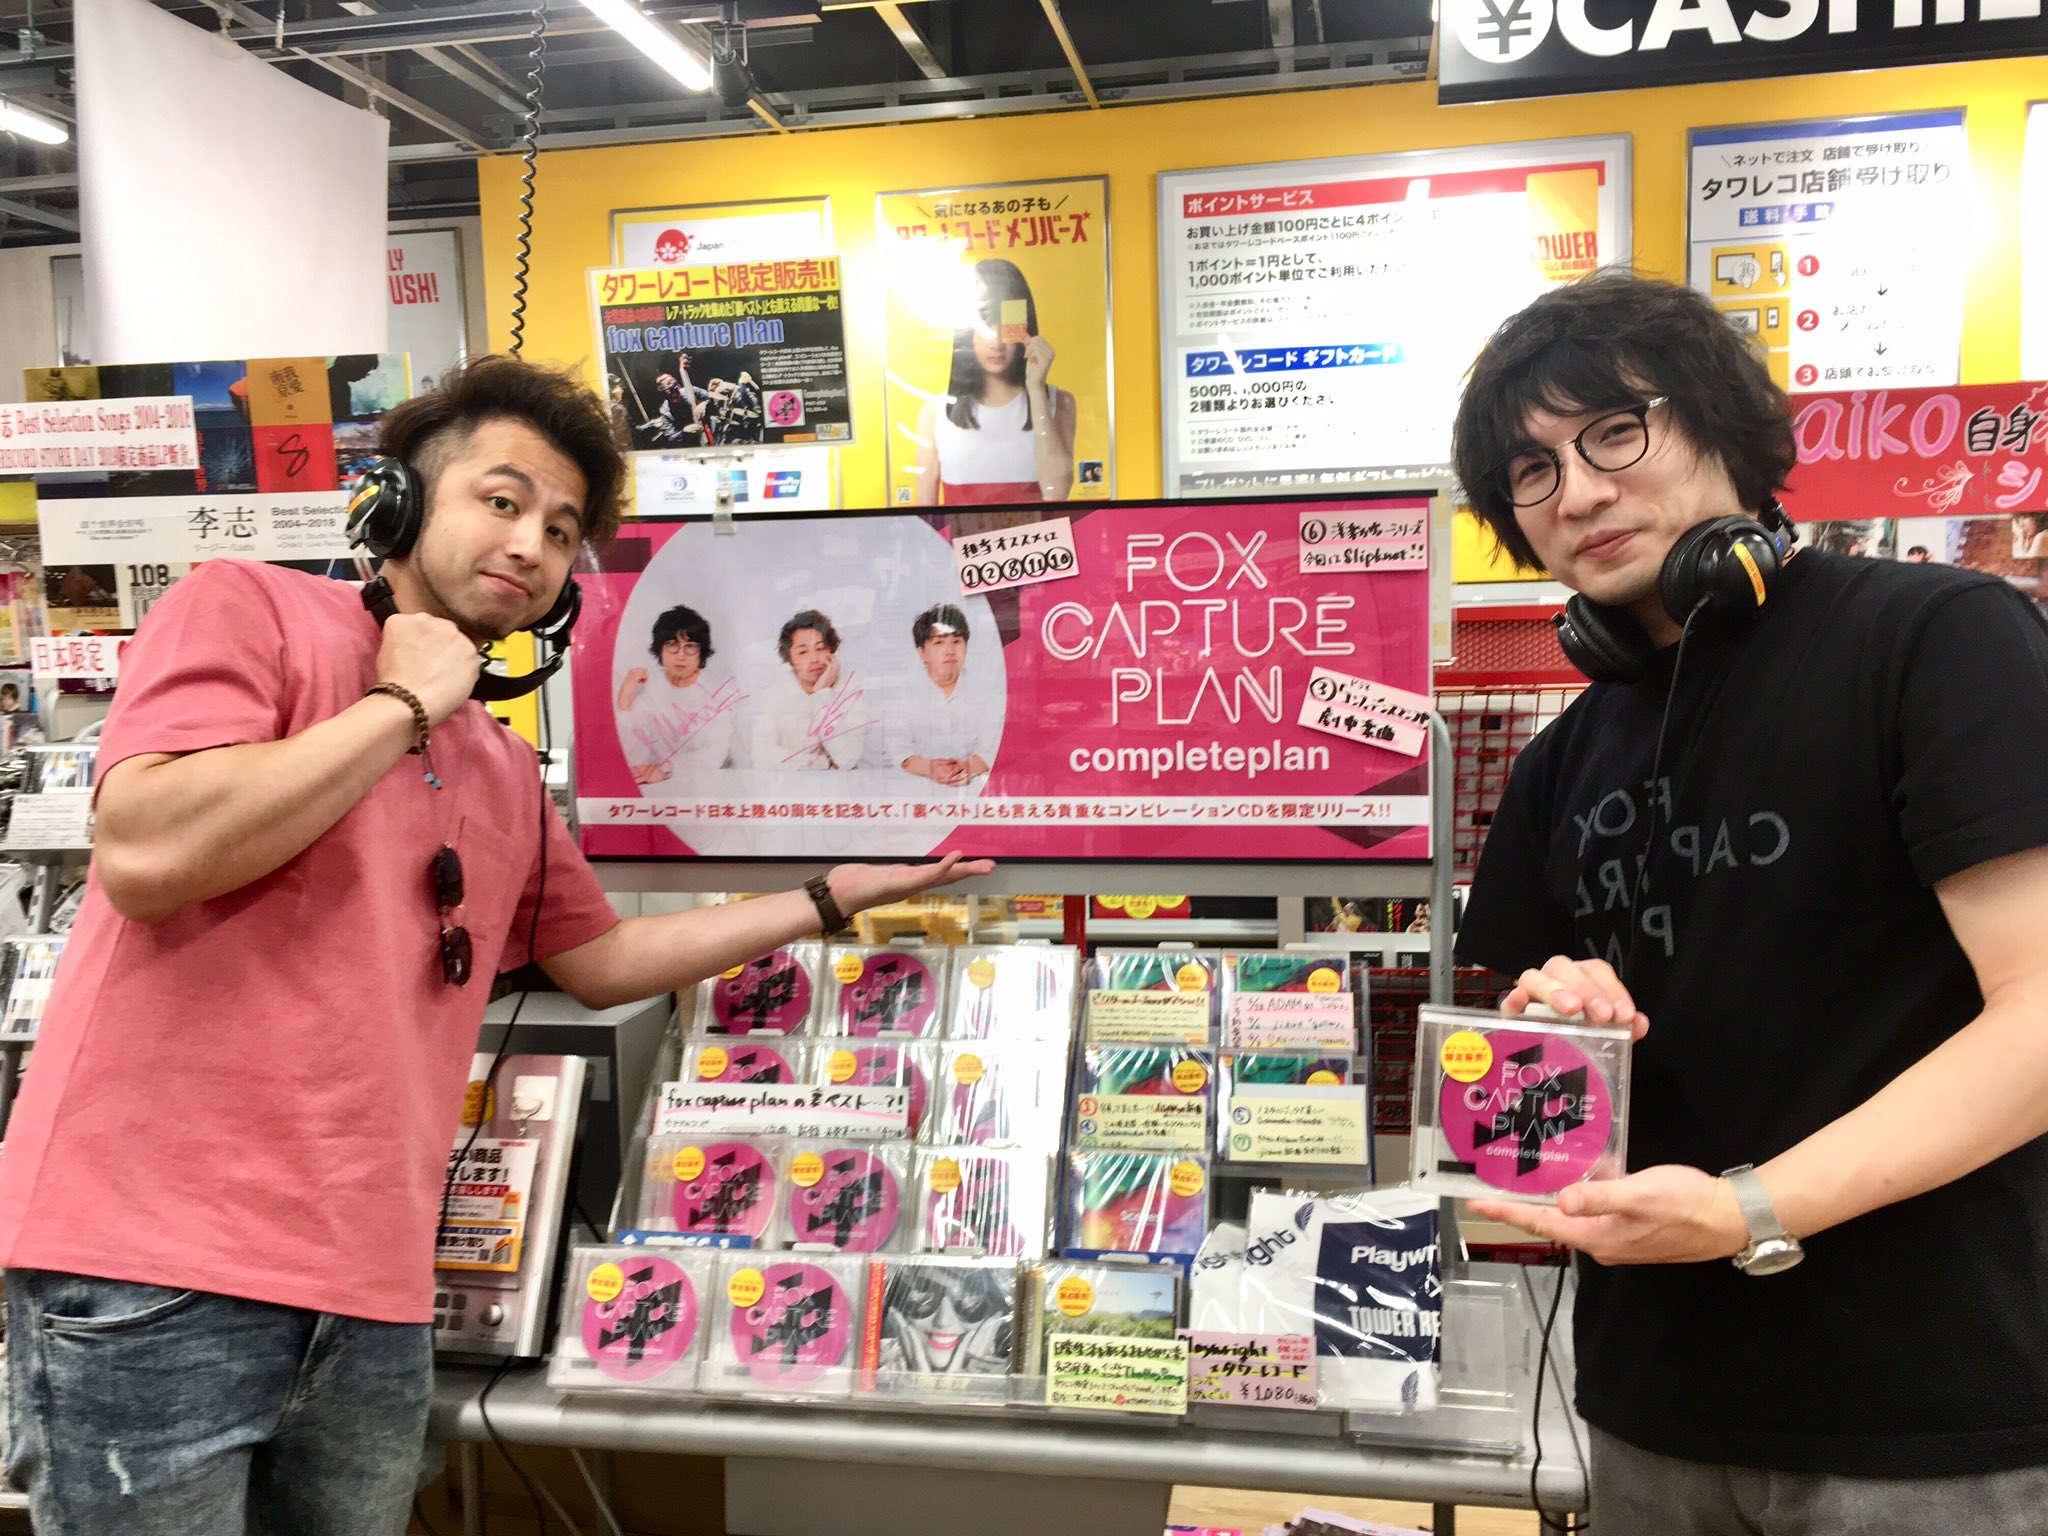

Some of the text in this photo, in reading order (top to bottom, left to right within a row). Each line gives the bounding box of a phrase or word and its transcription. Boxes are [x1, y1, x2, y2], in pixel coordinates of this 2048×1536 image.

[1702, 162, 1950, 201] タワレコ店舗受け取り
[934, 198, 1051, 217] 気になるあの子も
[1188, 190, 1314, 213] ポイントサービス
[1533, 231, 1598, 260] OWER
[602, 259, 837, 302] タワーレコード限定販売!!
[608, 316, 784, 354] fox capture plan
[1191, 345, 1398, 374] タワーレコード ギフトカード
[16, 410, 41, 435] Best
[97, 406, 131, 435] Songs
[1794, 390, 1961, 464] aiko
[187, 506, 258, 539] 李志
[272, 507, 299, 517] Best
[1127, 529, 1268, 592] FOX
[1041, 595, 1356, 660] CAPTURE
[36, 640, 104, 672] 日本限定
[1112, 664, 1283, 726] PLAN
[1068, 739, 1331, 780] completeplan
[1501, 1061, 1563, 1092] FOX
[668, 1088, 692, 1109] fox
[749, 1092, 788, 1114] plan
[1464, 1085, 1597, 1121] CAPTURE
[1492, 1113, 1565, 1145] PLAN
[1486, 1145, 1569, 1163] completeplan
[621, 1280, 666, 1301] FOX
[774, 1286, 816, 1306] FOX
[595, 1301, 687, 1321] CAPTURE
[745, 1306, 838, 1328] CAPTURE
[1349, 1306, 1416, 1337] TOWER
